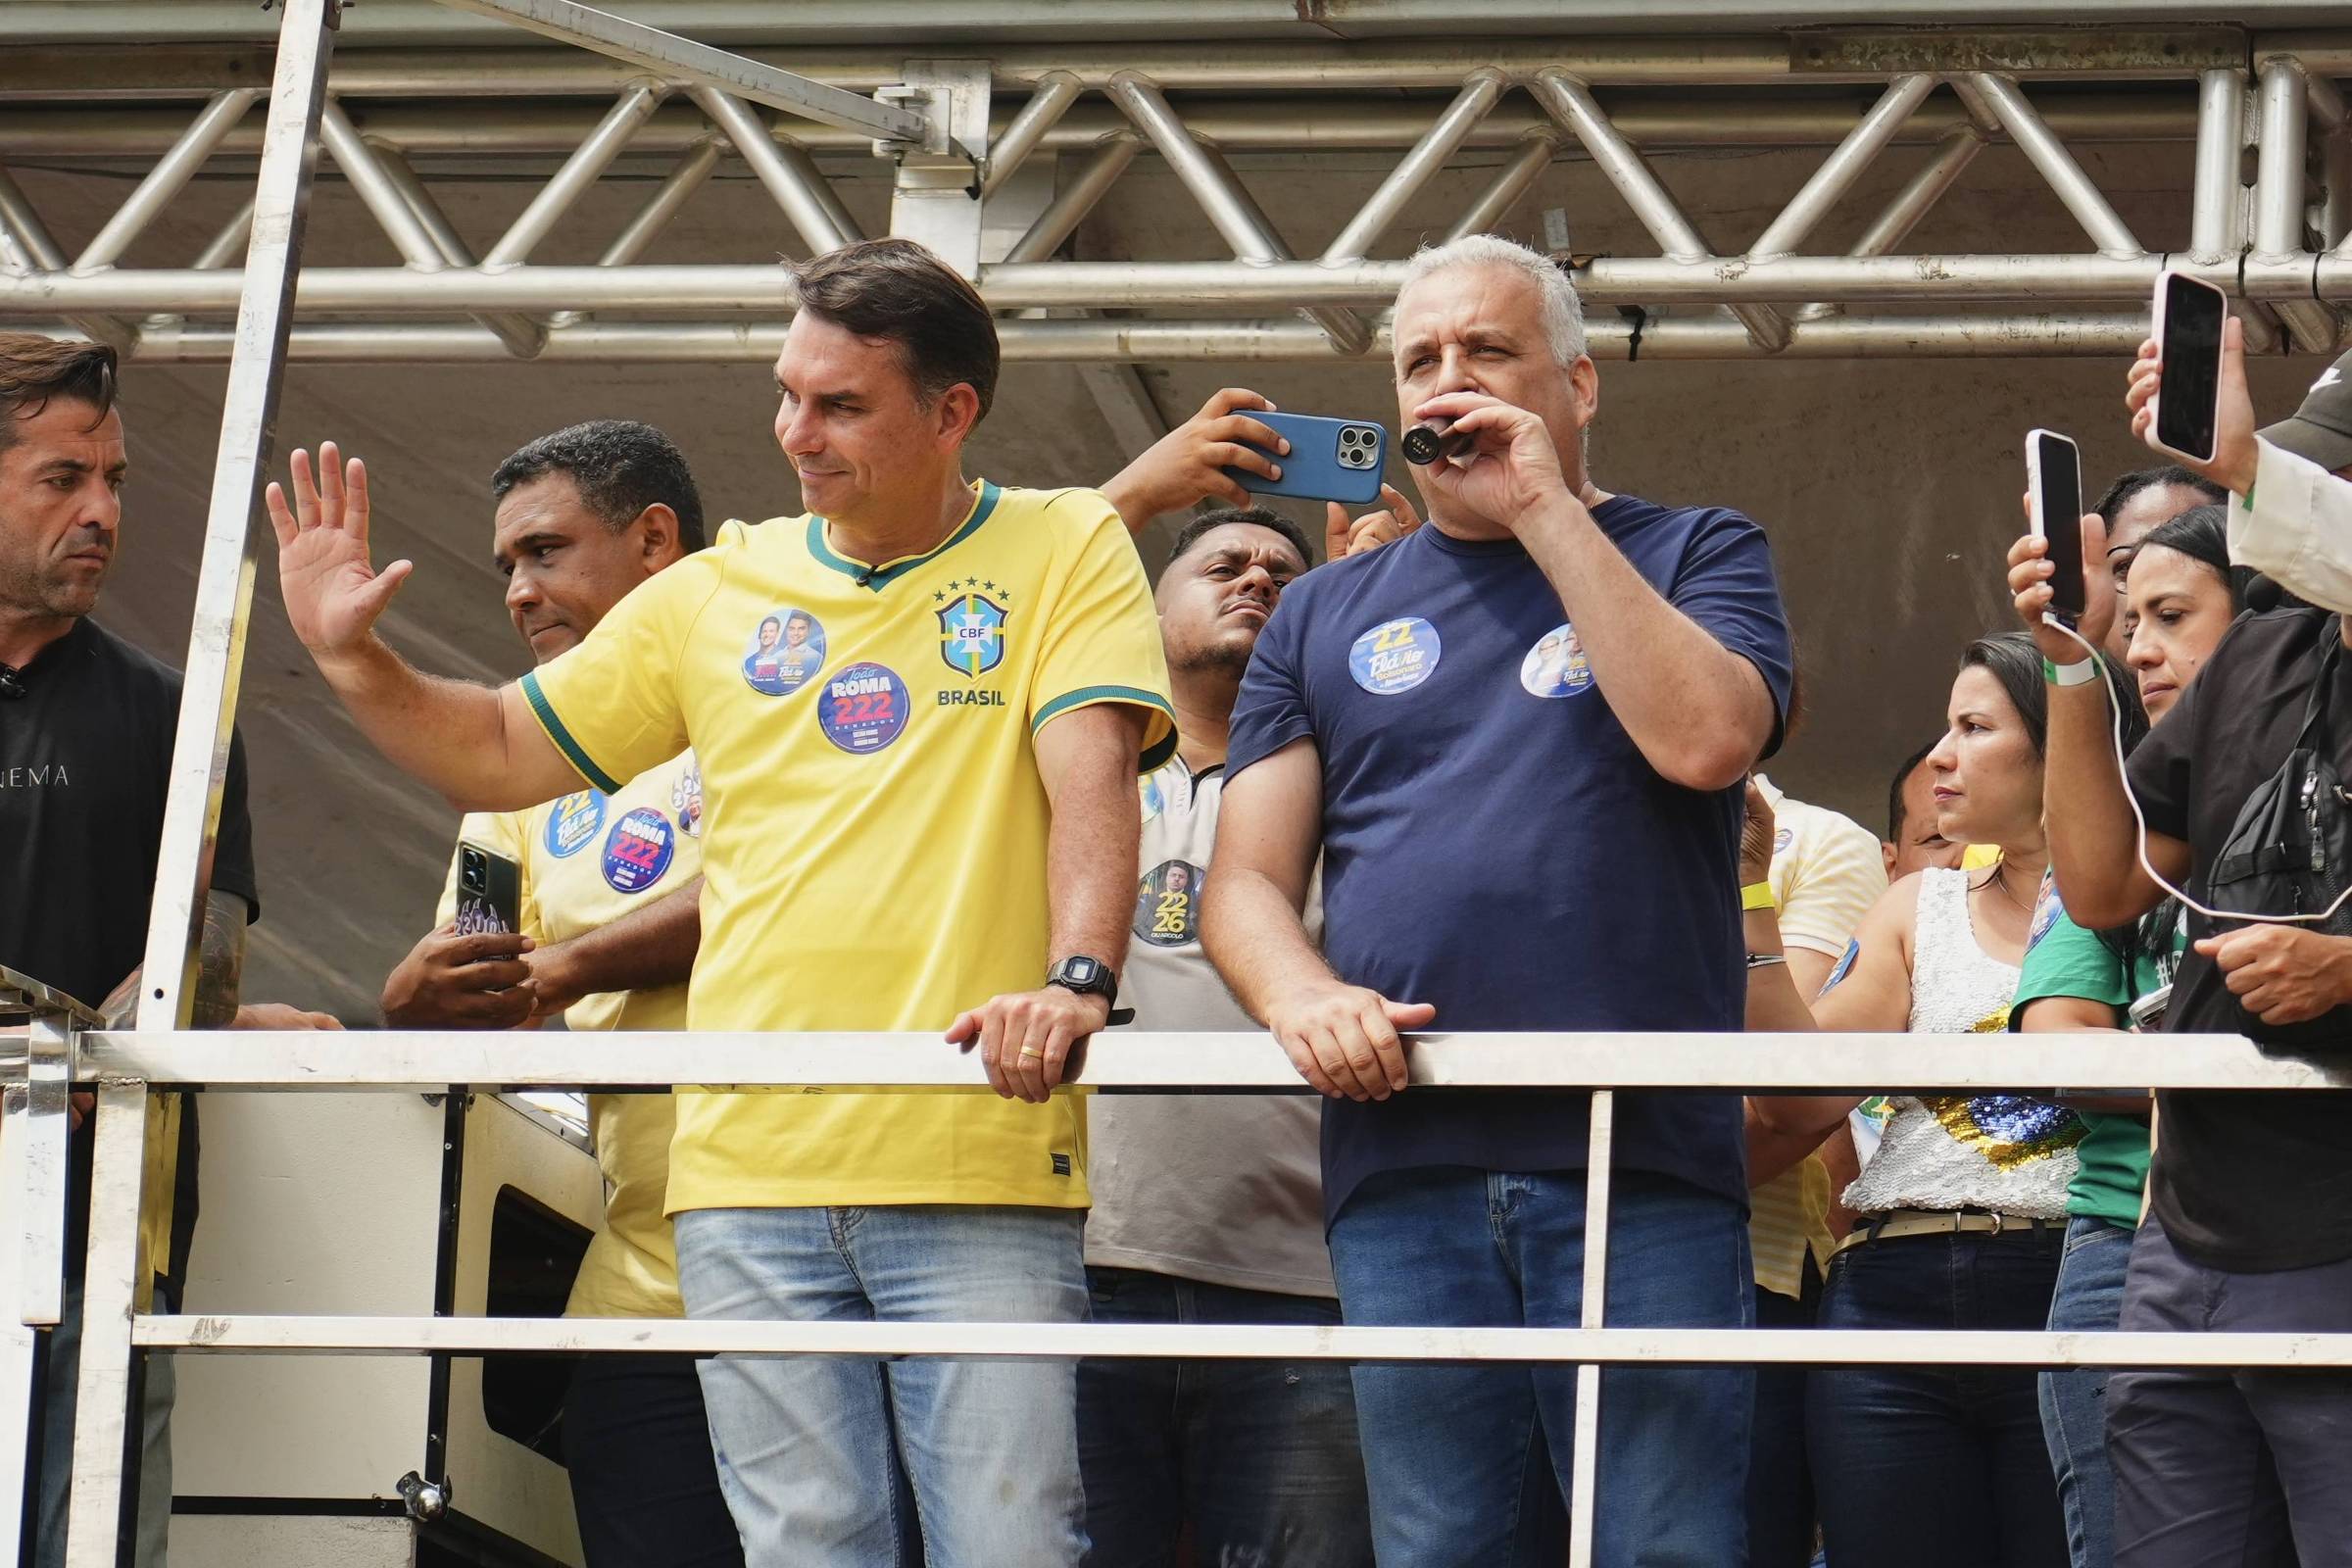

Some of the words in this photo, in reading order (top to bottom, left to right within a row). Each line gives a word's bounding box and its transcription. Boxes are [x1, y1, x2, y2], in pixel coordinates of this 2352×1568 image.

[959, 627, 986, 638] CBF
[1374, 622, 1414, 653] 22
[831, 676, 893, 698] ROMA
[938, 689, 1006, 706] BRASIL
[833, 692, 895, 725] 222
[0, 764, 69, 788] EMA
[621, 817, 666, 847] ROMA
[612, 832, 660, 870] 222
[1156, 891, 1189, 912] 22
[1152, 911, 1186, 933] 26
